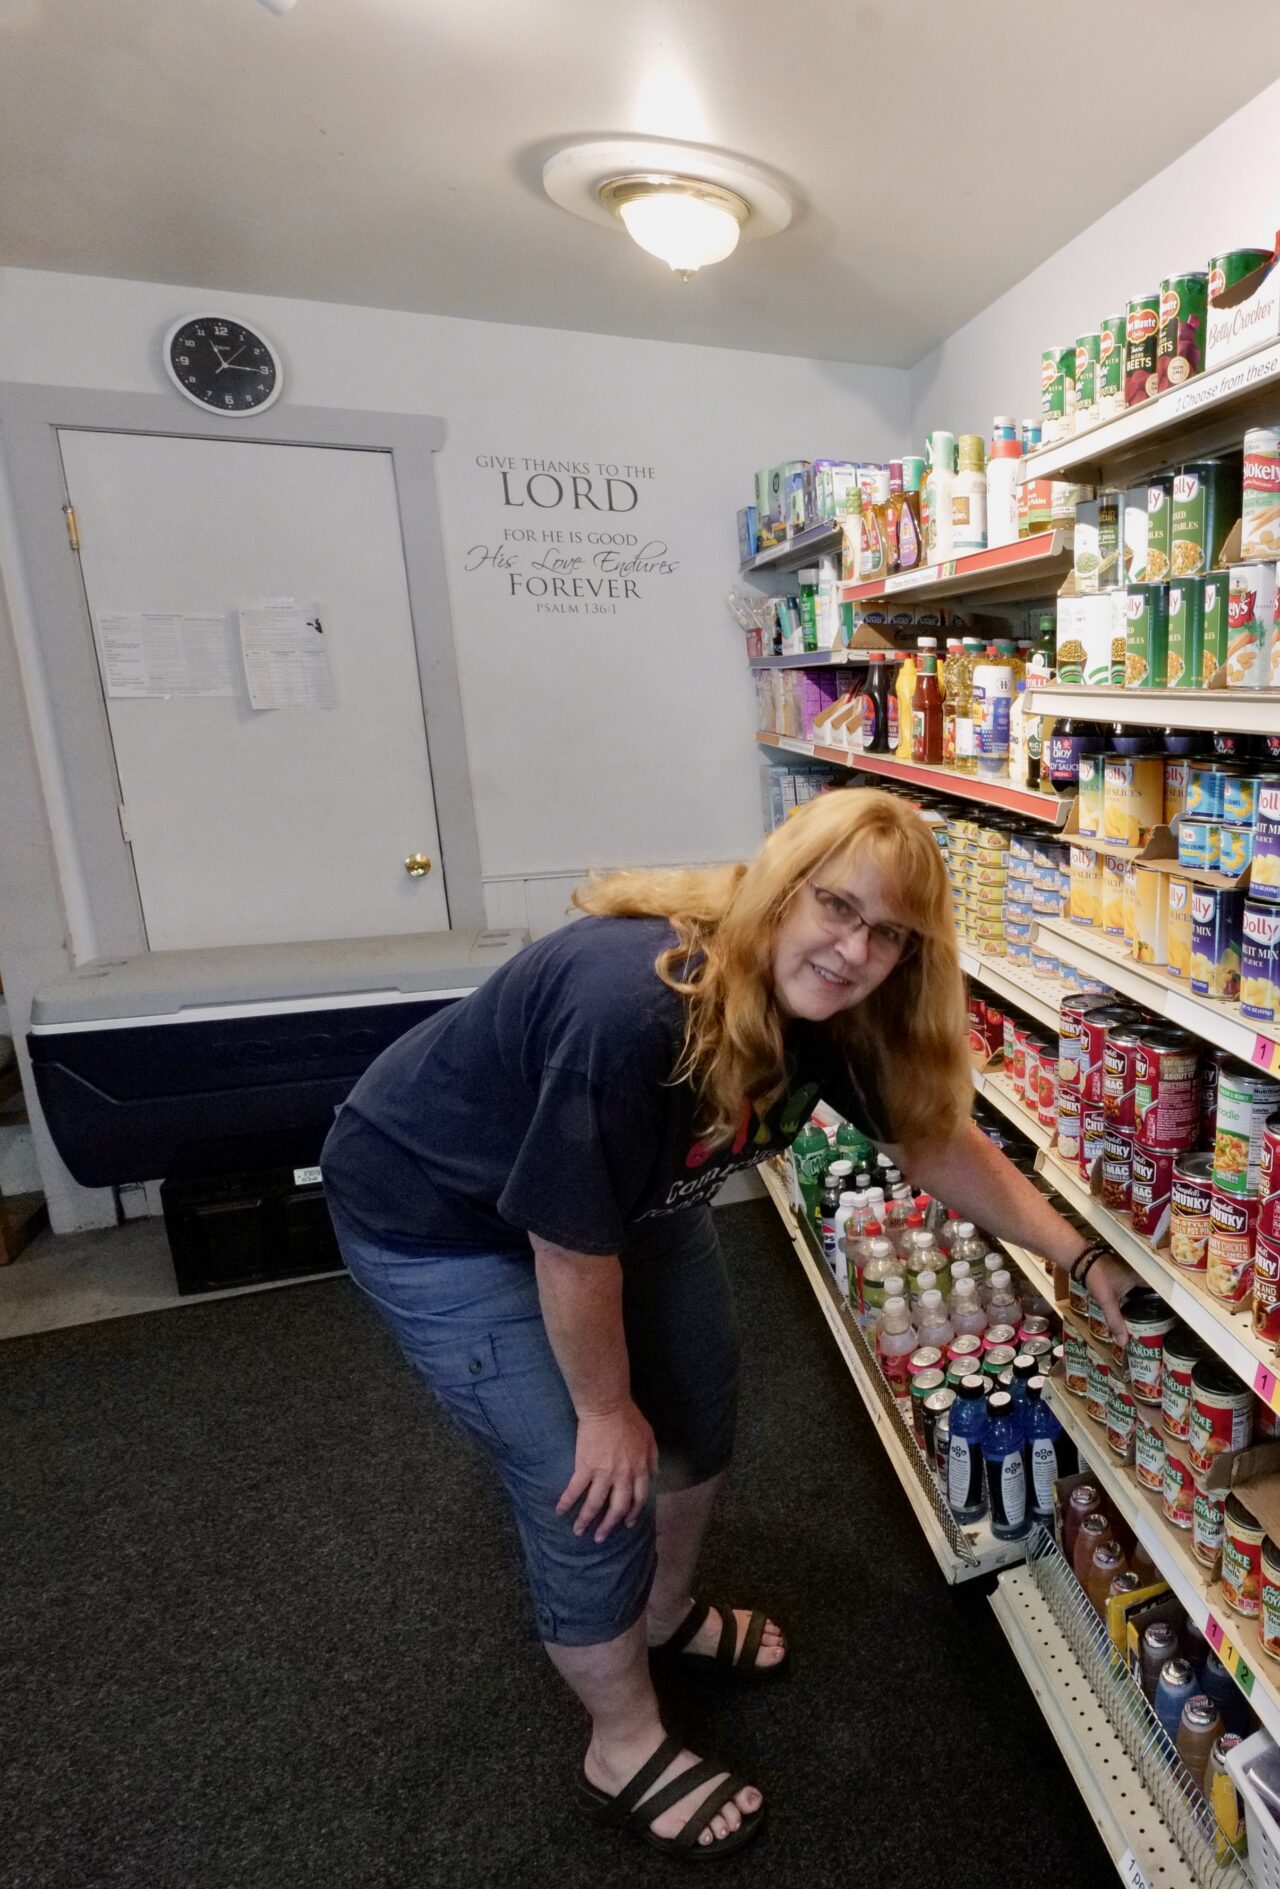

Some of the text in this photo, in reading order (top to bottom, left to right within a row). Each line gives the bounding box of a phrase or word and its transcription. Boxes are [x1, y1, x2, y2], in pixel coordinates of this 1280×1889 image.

[214, 327, 228, 336] 12
[180, 356, 189, 365] 9
[1127, 357, 1152, 371] BEETS
[261, 366, 268, 375] 3
[1183, 385, 1218, 409] Choose
[1220, 369, 1244, 394] from
[1246, 358, 1278, 384] these
[224, 396, 234, 405] 6
[476, 455, 656, 480] GIVE THANKS TO THE
[500, 472, 638, 512] LORD
[504, 529, 637, 546] FOR HE IS GOOD
[465, 540, 680, 577] His Love Endures
[509, 573, 643, 599] FOREVER
[537, 603, 616, 614] PSALM 136:1
[1053, 749, 1073, 759] CHOY
[1106, 1078, 1124, 1091] MAC
[1107, 1165, 1130, 1177] MAC
[1135, 1185, 1153, 1198] MAC
[1172, 1192, 1210, 1211] CHUNKY
[1259, 1373, 1267, 1391] 1
[1211, 1623, 1249, 1684] 1 1 2
[1128, 1859, 1136, 1871] 1
